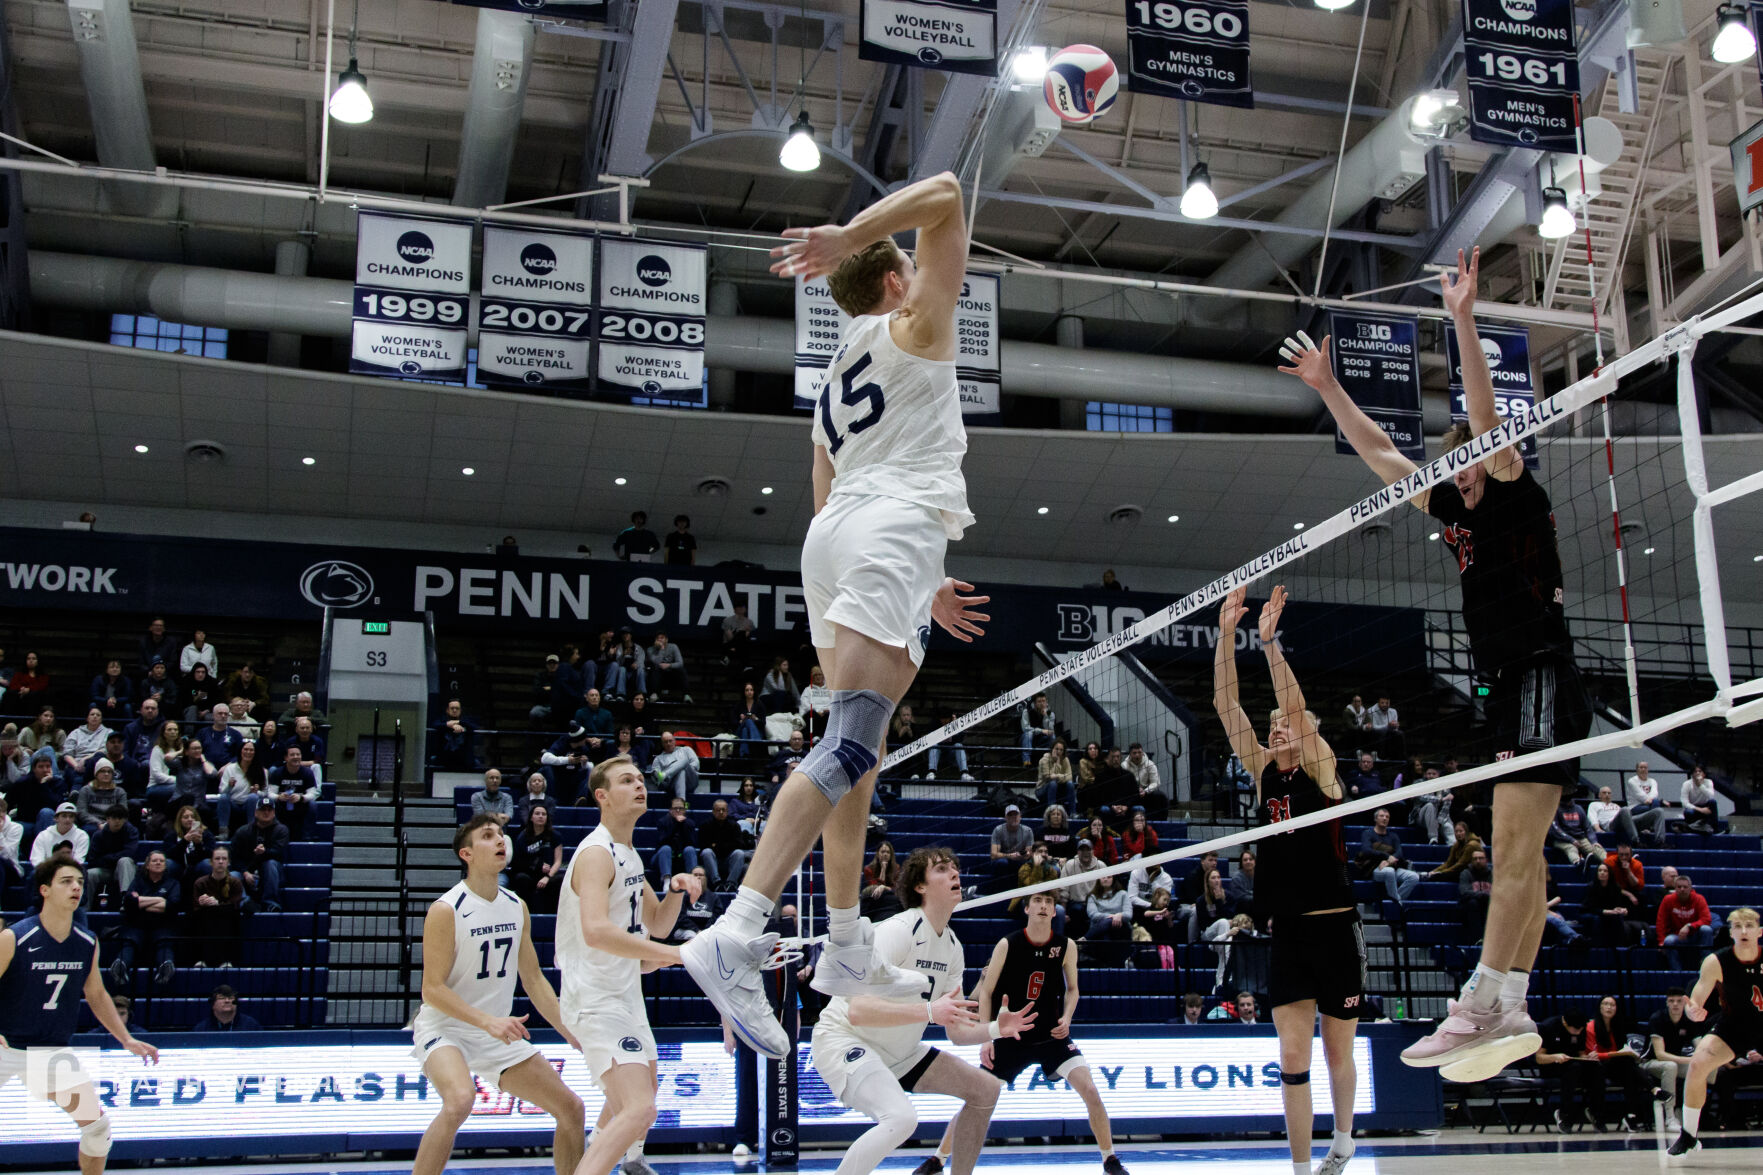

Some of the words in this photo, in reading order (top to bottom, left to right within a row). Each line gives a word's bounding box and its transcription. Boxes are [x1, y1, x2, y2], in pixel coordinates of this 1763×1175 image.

[1505, 0, 1537, 12] NCAA
[895, 14, 964, 34] WOMEN'S
[1135, 1, 1242, 38] 1960
[884, 26, 975, 48] VOLLEYBALL
[1474, 17, 1568, 40] CHAMPIONS
[1169, 50, 1213, 66] MEN'S
[1147, 59, 1236, 81] GYMNASTICS
[1478, 52, 1566, 85] 1961
[1058, 84, 1069, 112] NCAA
[1507, 100, 1546, 115] MEN'S
[1487, 109, 1567, 128] GYMNASTICS
[400, 244, 434, 258] NCAA
[367, 262, 464, 282] CHAMPIONS
[523, 258, 557, 270] NCAA
[491, 274, 585, 293] CHAMPIONS
[639, 269, 671, 281] NCAA
[609, 286, 700, 304] CHAMPIONS
[362, 294, 462, 323] 1999
[808, 307, 839, 316] 1992
[482, 304, 589, 333] 2007
[808, 319, 839, 328] 1996
[958, 318, 990, 328] 2006
[601, 315, 705, 343] 2008
[808, 331, 839, 340] 1998
[958, 328, 990, 338] 2008
[381, 335, 443, 349] WOMEN'S
[806, 342, 840, 351] 2003
[960, 337, 989, 347] 2010
[1339, 338, 1411, 354] CHAMPIONS
[371, 345, 451, 361] VOLLEYBALL
[506, 346, 565, 359] WOMEN'S
[960, 346, 989, 356] 2013
[496, 355, 573, 370] VOLLEYBALL
[624, 355, 682, 369] WOMEN'S
[1342, 357, 1371, 367] 2003
[1381, 361, 1410, 371] 2008
[615, 365, 690, 380] VOLLEYBALL
[1345, 369, 1371, 378] 2015
[1383, 372, 1409, 382] 2019
[819, 351, 885, 459] 15
[1350, 490, 1390, 523] PENN
[1394, 460, 1442, 499] STATE
[1446, 397, 1563, 471] VOLLEYBALL
[0, 562, 118, 594] WORK
[1168, 594, 1195, 620] PENN
[1197, 575, 1230, 604] STATE
[1232, 534, 1308, 585] VOLLEYBALL
[414, 565, 590, 620] PENN
[626, 576, 806, 631] STATE
[365, 622, 388, 632] EXIT
[366, 651, 387, 667] S3
[1040, 669, 1060, 687] PENN
[1060, 653, 1084, 675] STATE
[1086, 625, 1139, 661] VOLLEYBALL
[944, 721, 960, 736] PENN
[960, 711, 978, 727] STATE
[979, 690, 1019, 719] VOLLEYBALL
[470, 925, 493, 937] PENN
[494, 922, 517, 933] STATE
[31, 961, 57, 970] PENN
[57, 961, 83, 970] STATE
[477, 937, 513, 979] 17
[916, 959, 932, 969] PENN
[42, 974, 69, 1010] 7
[1026, 970, 1045, 1001] 6
[777, 1056, 788, 1084] PENN
[1144, 1061, 1283, 1090] LIONS
[235, 1072, 428, 1104] FLASH
[778, 1087, 788, 1119] STATE
